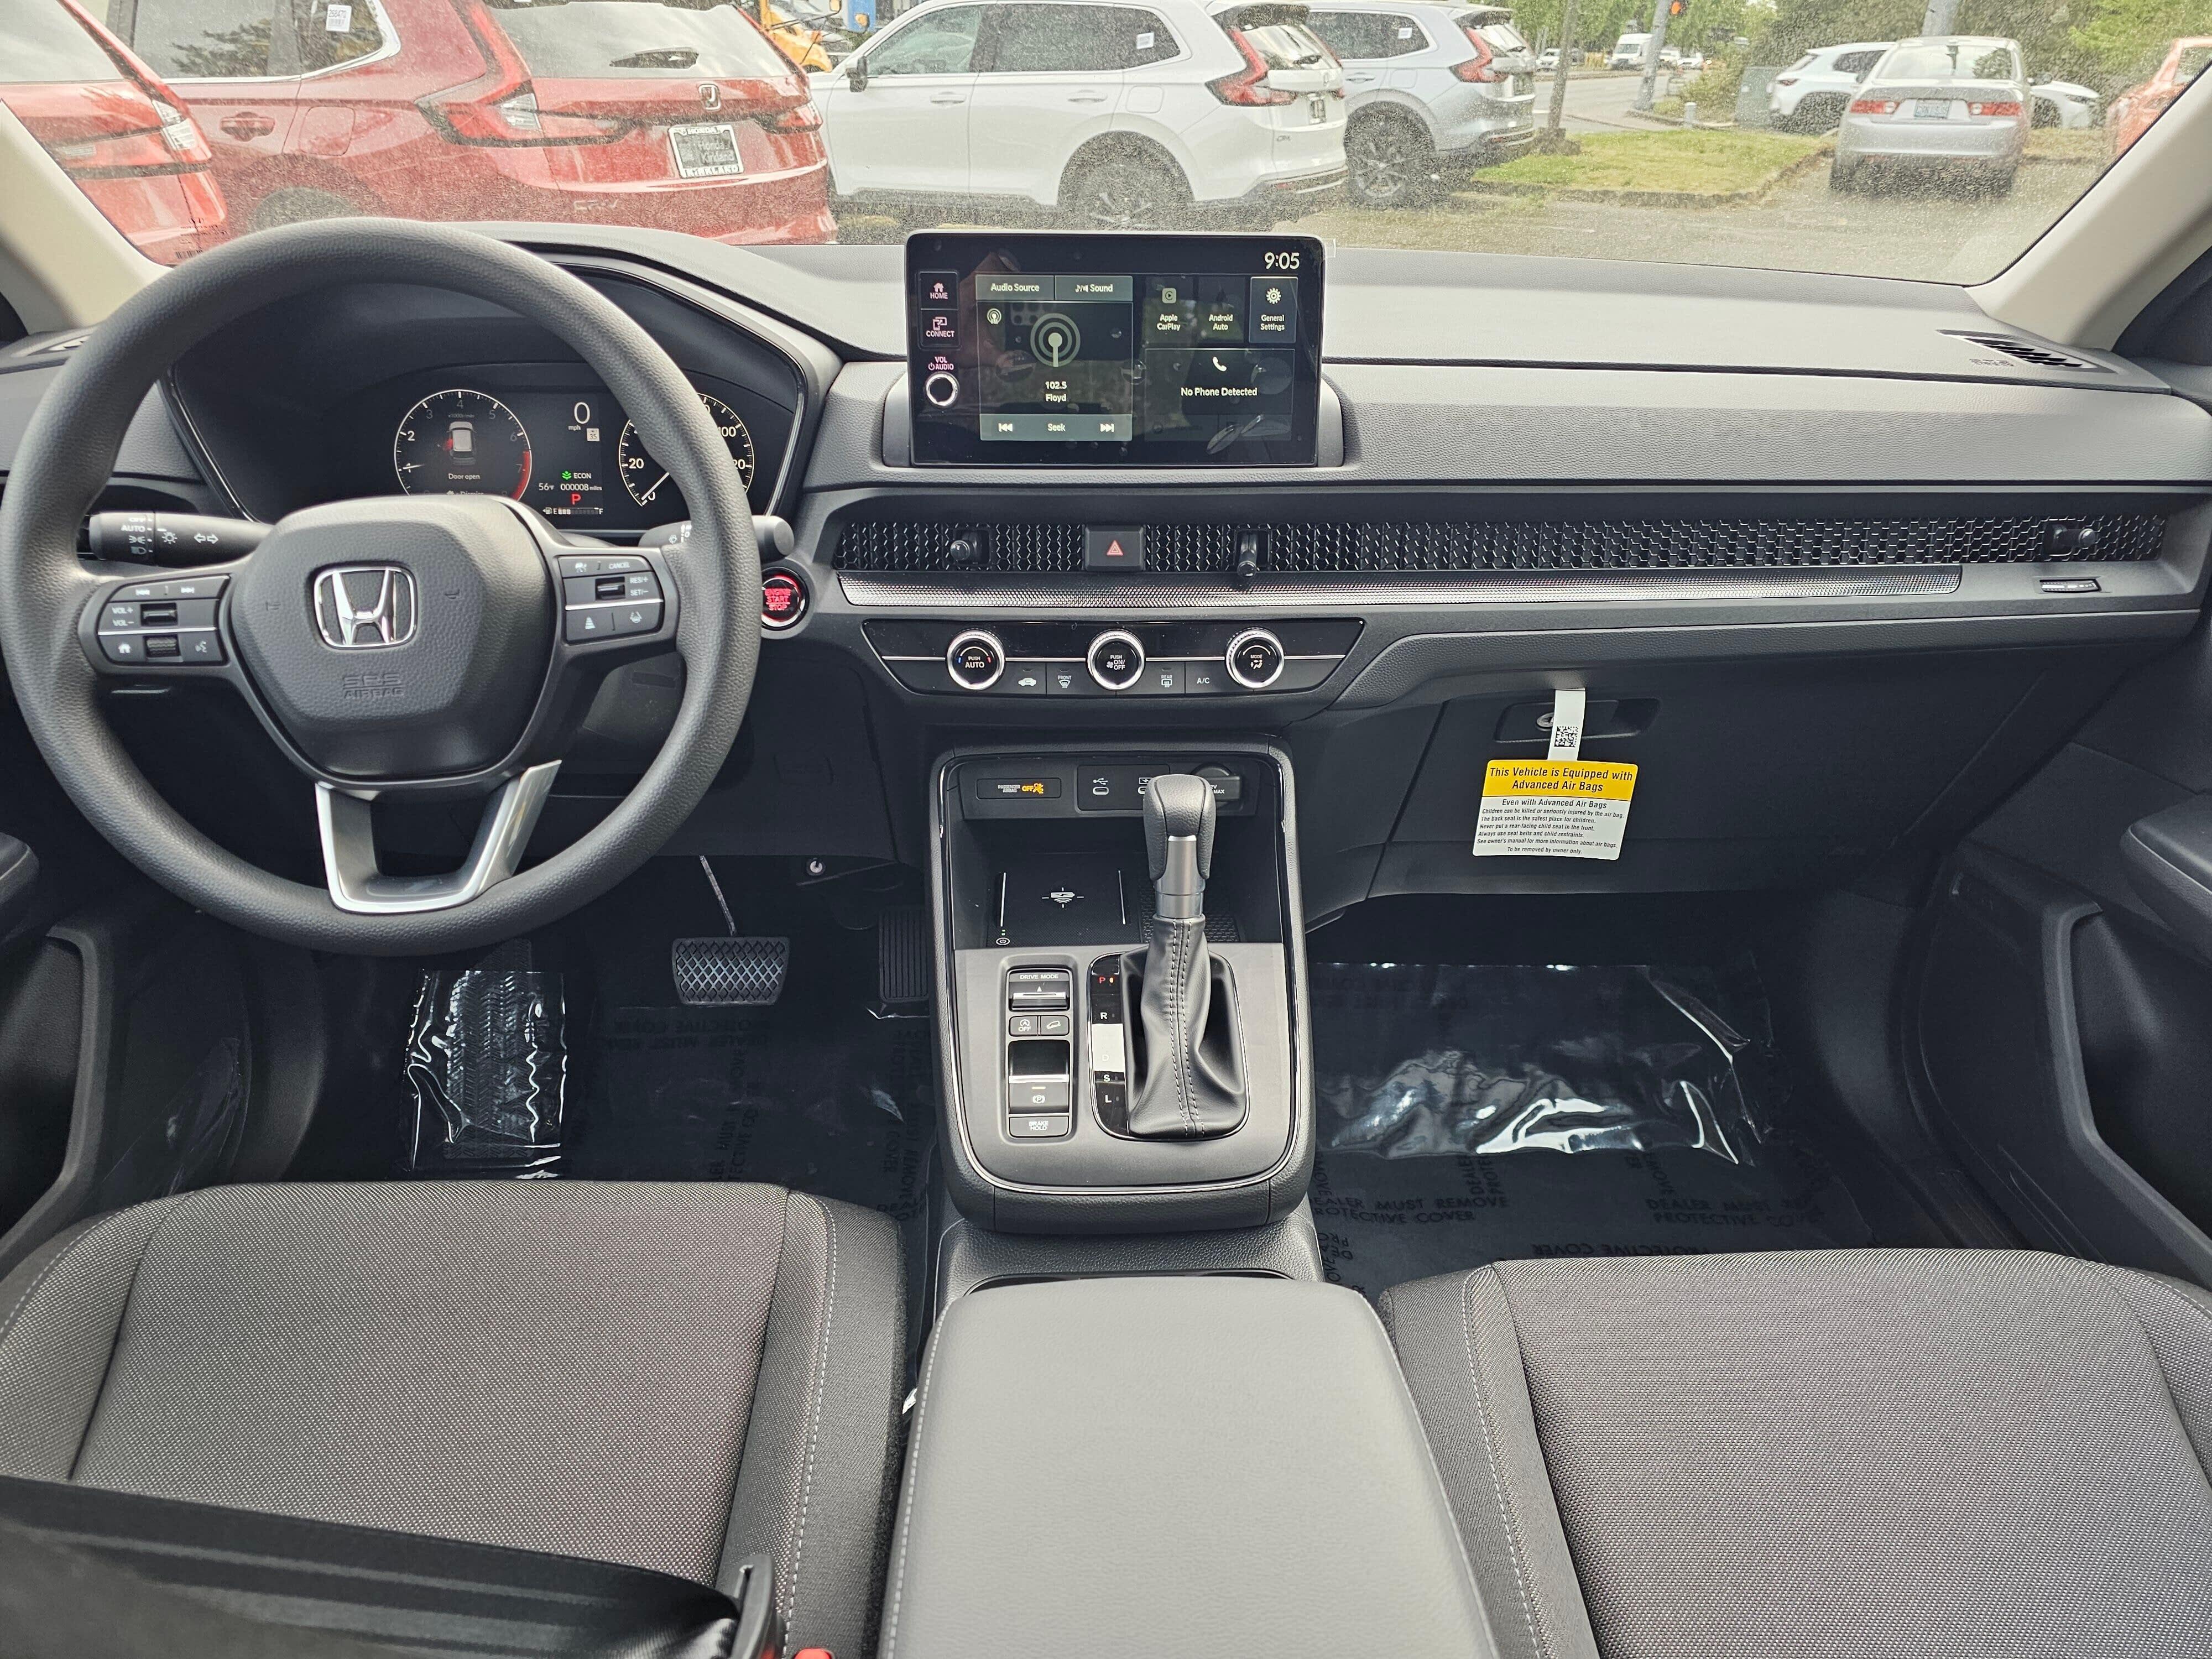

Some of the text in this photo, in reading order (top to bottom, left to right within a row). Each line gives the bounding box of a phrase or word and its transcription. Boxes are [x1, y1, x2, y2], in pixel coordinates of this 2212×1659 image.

[686, 166, 739, 176] KIRKLAND
[1264, 252, 1300, 269] 9:05
[990, 283, 1040, 293] Audio Source
[1089, 283, 1113, 293] Sound
[1159, 314, 1178, 324] Apple
[1208, 314, 1233, 323] Android
[1261, 314, 1285, 322] General
[1156, 322, 1181, 332] CarPlay
[1213, 322, 1229, 331] Auto
[1260, 322, 1285, 332] Settings
[1045, 381, 1067, 390] 102.5
[1181, 387, 1258, 397] No Phone Detected
[1045, 393, 1067, 403] Floyd
[457, 400, 463, 409] 4
[426, 409, 433, 419] 3
[489, 410, 496, 419] 5
[574, 402, 590, 424] 0
[1047, 423, 1066, 432] Seek
[408, 430, 415, 441] 2
[510, 432, 517, 442] 6
[516, 463, 523, 473] 7
[629, 458, 644, 469] 20
[734, 459, 745, 469] 20
[572, 493, 581, 505] P
[764, 588, 791, 597] ENGINE
[1490, 767, 1632, 781] This Vehicle is Equipped with
[1512, 780, 1603, 792] Advanced Air Bags
[1589, 801, 1607, 809] Bags
[1105, 1095, 1112, 1103] L
[1375, 1198, 1423, 1211] MUST
[1435, 1196, 1510, 1208] REMOVE
[1416, 1211, 1476, 1223] COVER
